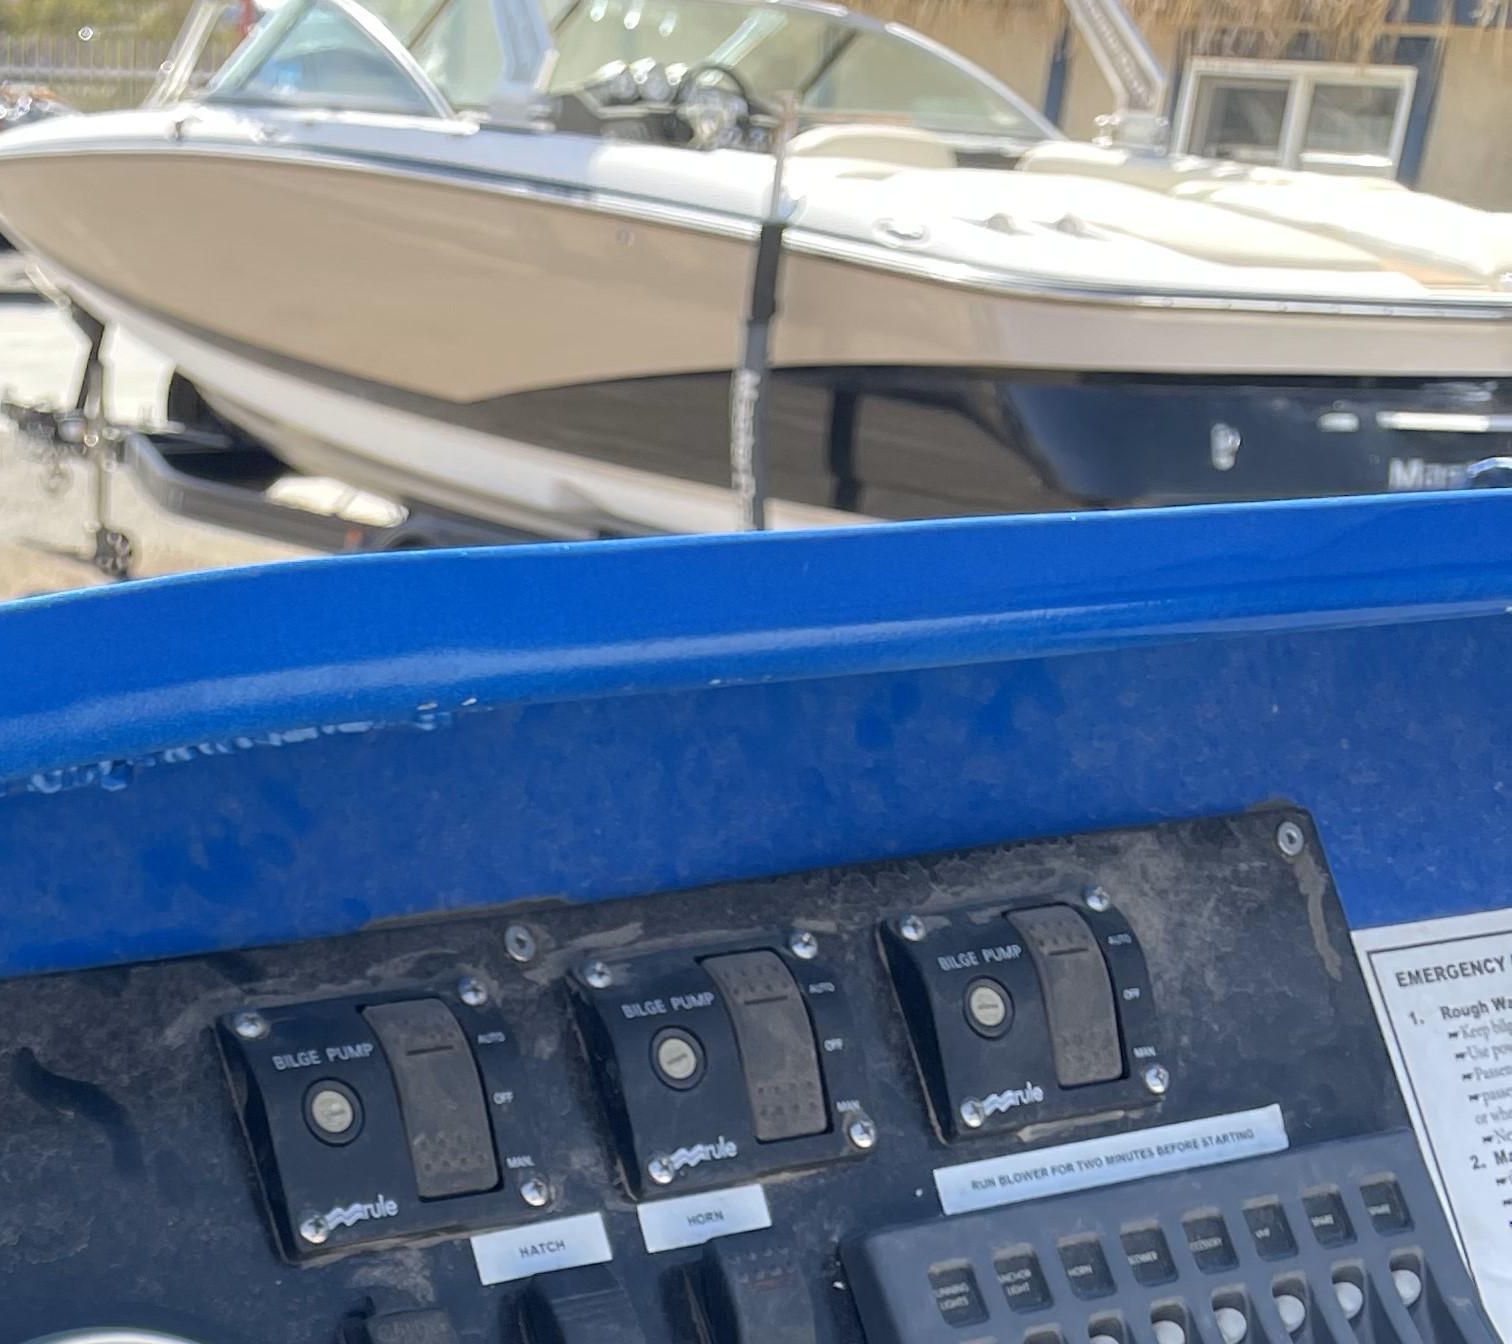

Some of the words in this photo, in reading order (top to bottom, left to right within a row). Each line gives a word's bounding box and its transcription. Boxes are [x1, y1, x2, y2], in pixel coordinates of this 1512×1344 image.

[938, 953, 978, 972] BILGE
[983, 944, 1022, 964] PUMP
[1395, 956, 1505, 987] EMERGENCY
[621, 999, 667, 1019] BILGE
[670, 992, 715, 1011] PUMP
[1440, 1000, 1490, 1020] Rough
[272, 1050, 322, 1071] BILGE
[325, 1043, 374, 1063] PUMP
[1016, 1081, 1045, 1103] rule
[705, 1135, 738, 1159] rule
[971, 1175, 996, 1190] RUN
[999, 1167, 1048, 1186] BLOWER
[1051, 1163, 1075, 1177] FOR
[1078, 1158, 1104, 1172] TWO
[1105, 1148, 1155, 1167] MINUTES
[1156, 1139, 1198, 1157] BEFORE
[1202, 1128, 1255, 1149] STARTING
[364, 1194, 399, 1218] rule
[687, 1210, 725, 1225] HORN
[519, 1238, 567, 1259] HATCH
